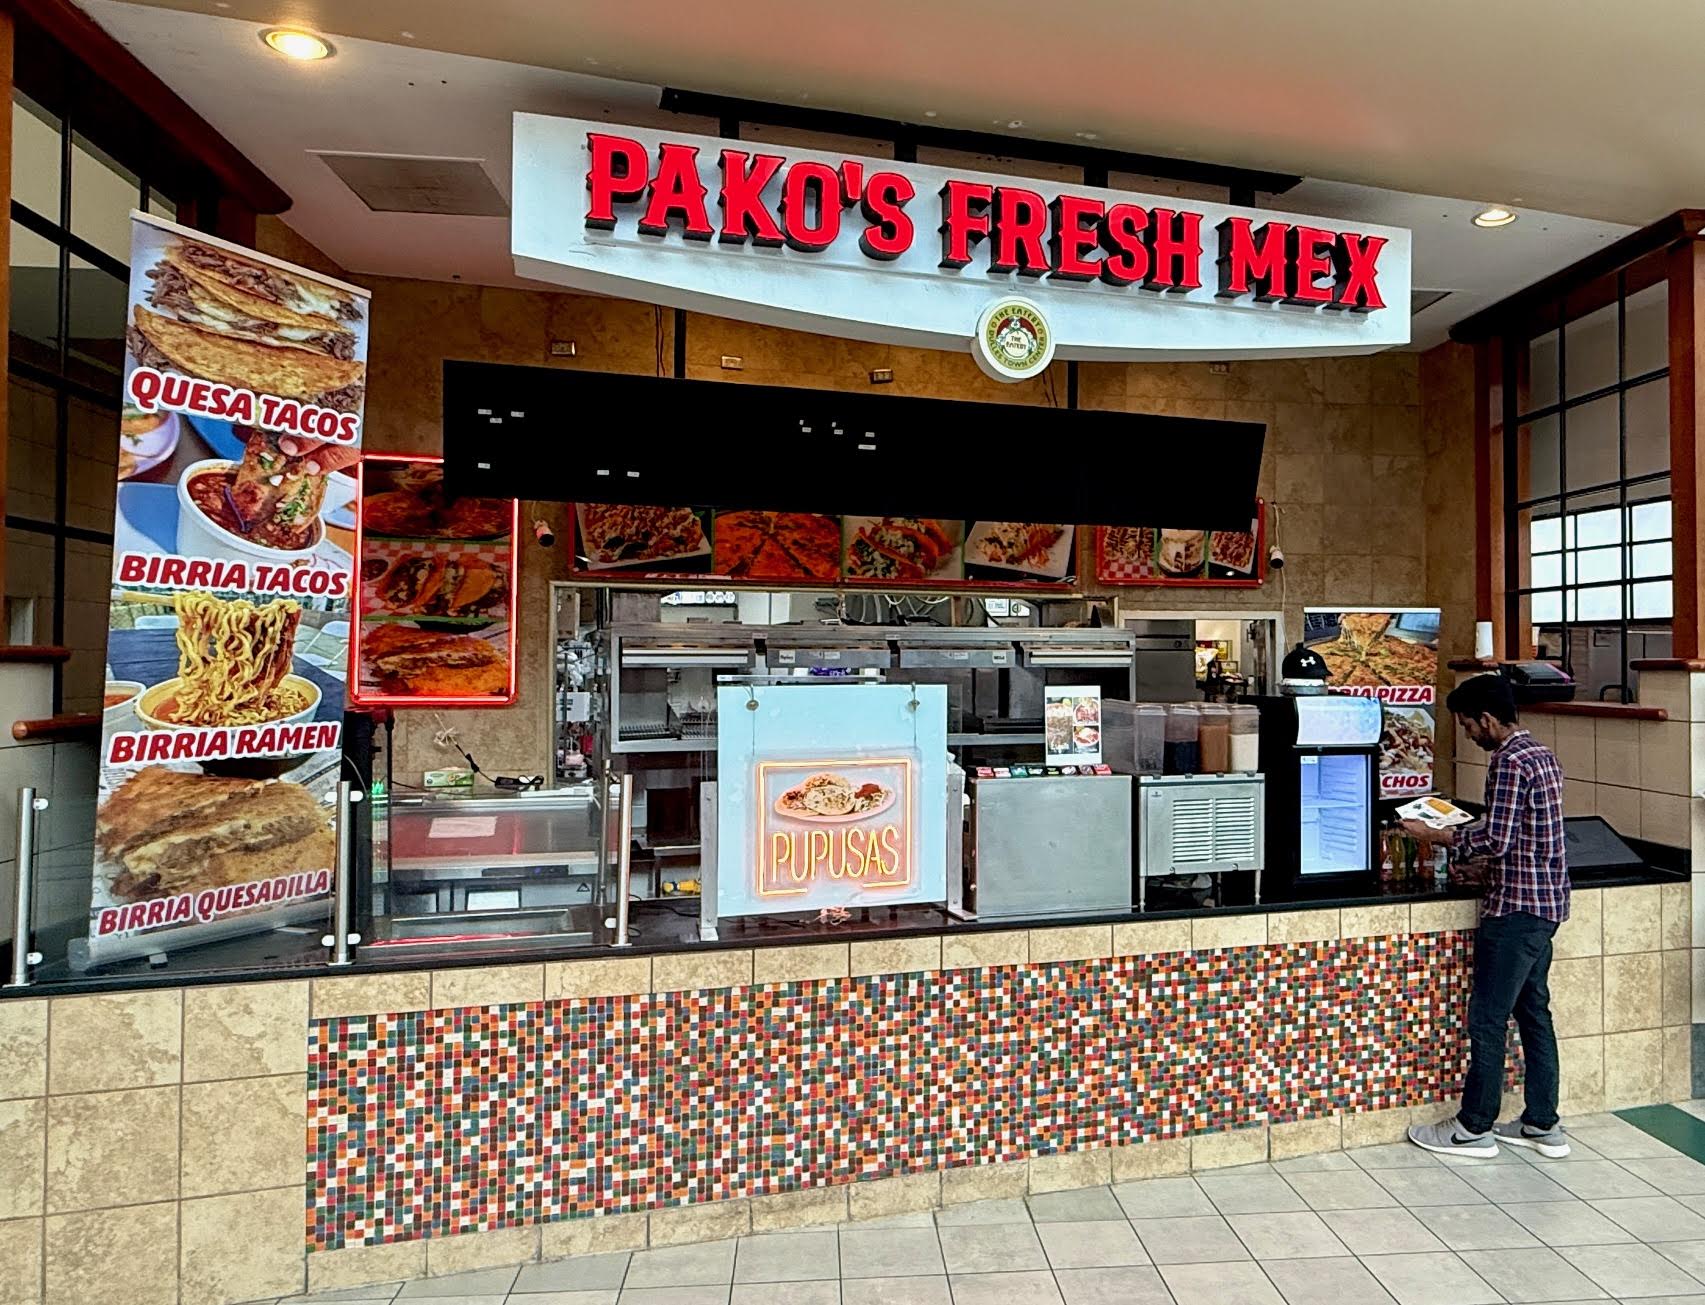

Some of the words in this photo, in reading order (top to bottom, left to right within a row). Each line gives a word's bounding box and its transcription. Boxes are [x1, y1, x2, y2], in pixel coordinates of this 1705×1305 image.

[586, 132, 916, 259] PAKO'S
[940, 180, 1204, 292] FRESH
[1218, 217, 1389, 312] MEX
[1011, 335, 1022, 343] THE
[1004, 357, 1028, 368] TOWN
[131, 371, 253, 422] QUESA
[261, 399, 359, 441] TACOS
[120, 555, 246, 589] BIRRIA
[255, 565, 349, 595] TACOS
[1377, 687, 1432, 703] PIZZA
[110, 730, 229, 763] BIRRIA
[235, 724, 339, 756] RAMEN
[1382, 775, 1430, 788] CHOS
[770, 826, 900, 882] PUPUSAS
[98, 895, 191, 934] BIRRIA
[197, 870, 330, 920] QUESADILLA
